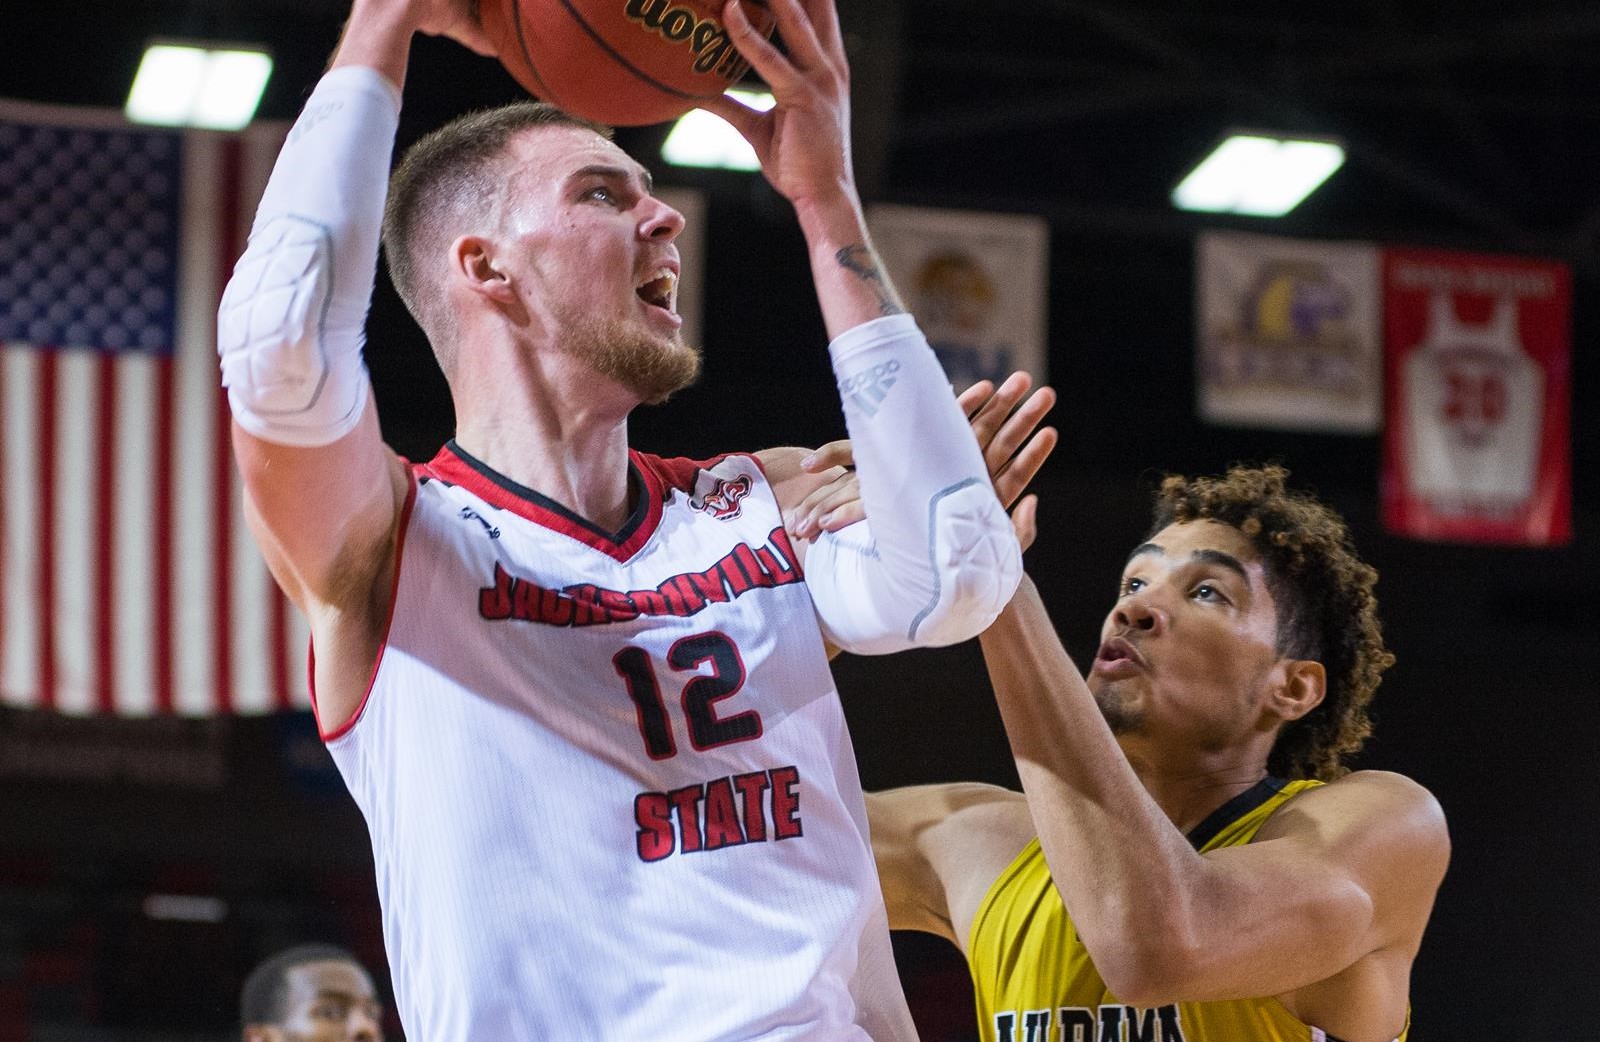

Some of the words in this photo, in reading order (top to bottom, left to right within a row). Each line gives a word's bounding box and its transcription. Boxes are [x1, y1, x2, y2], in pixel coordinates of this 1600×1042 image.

[624, 0, 750, 81] ilson
[612, 630, 764, 761] 12
[634, 765, 803, 863] STATE
